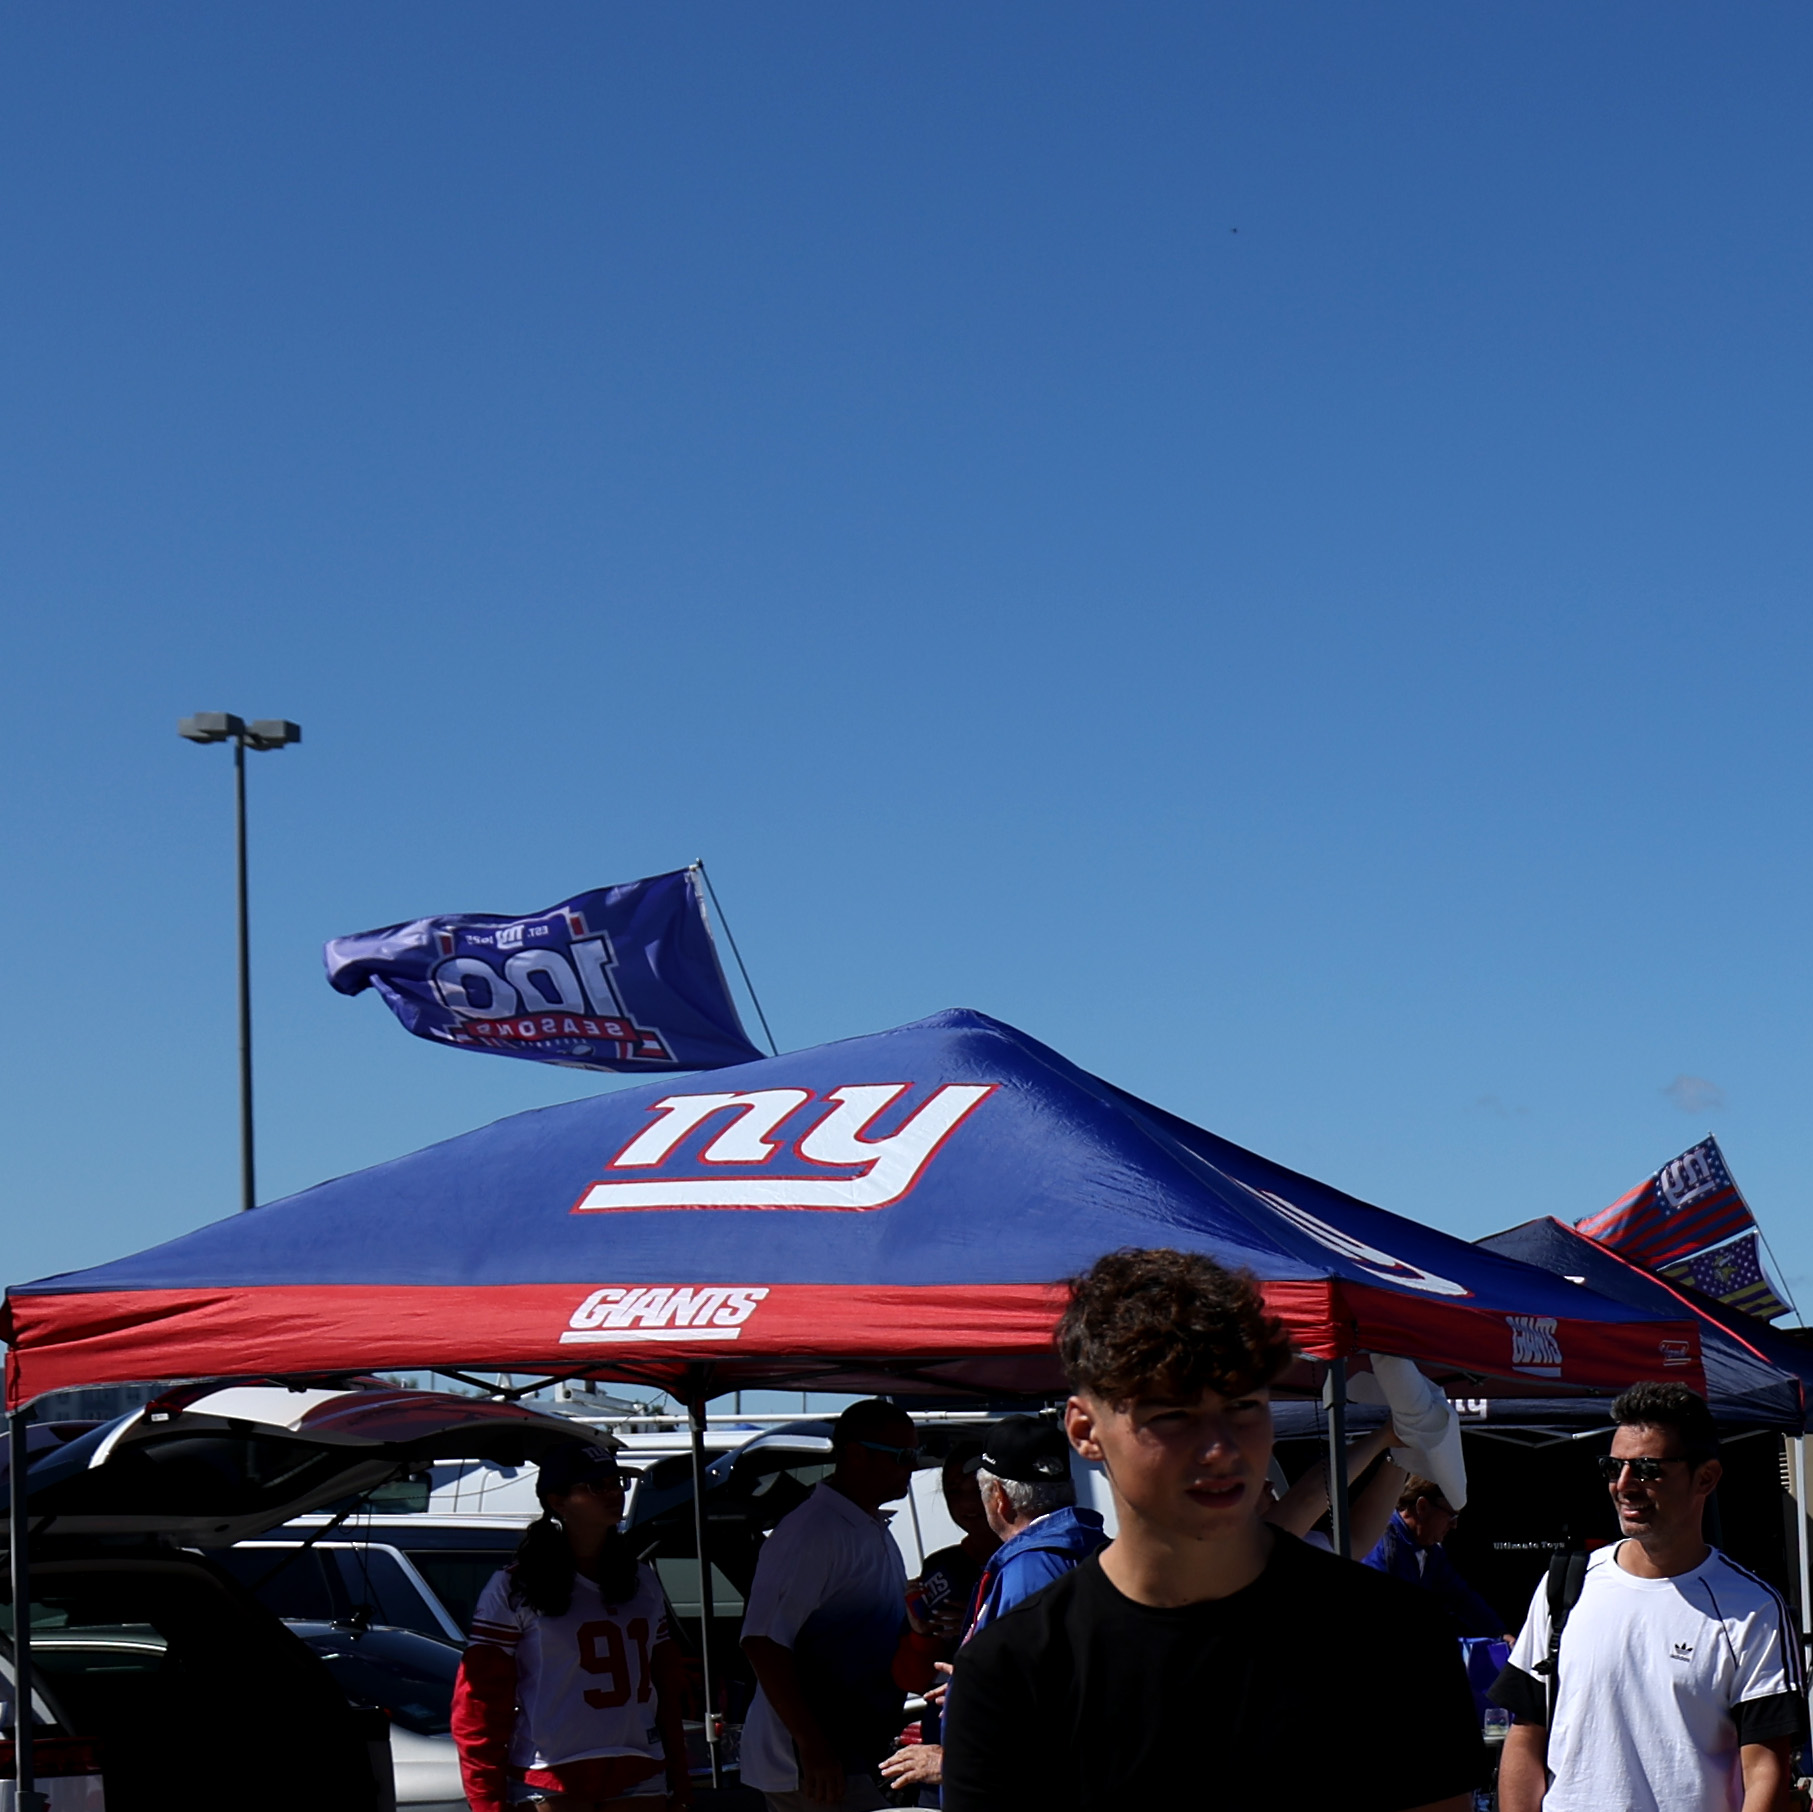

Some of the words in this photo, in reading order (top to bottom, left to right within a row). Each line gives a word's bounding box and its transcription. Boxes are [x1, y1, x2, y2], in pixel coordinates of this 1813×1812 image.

[572, 1083, 999, 1213] ny
[569, 1287, 770, 1329] GIANTS
[1506, 1316, 1563, 1365] GIANTS
[1493, 1541, 1539, 1550] Ultimate
[1541, 1540, 1566, 1549] Toys
[576, 1620, 656, 1709] 91
